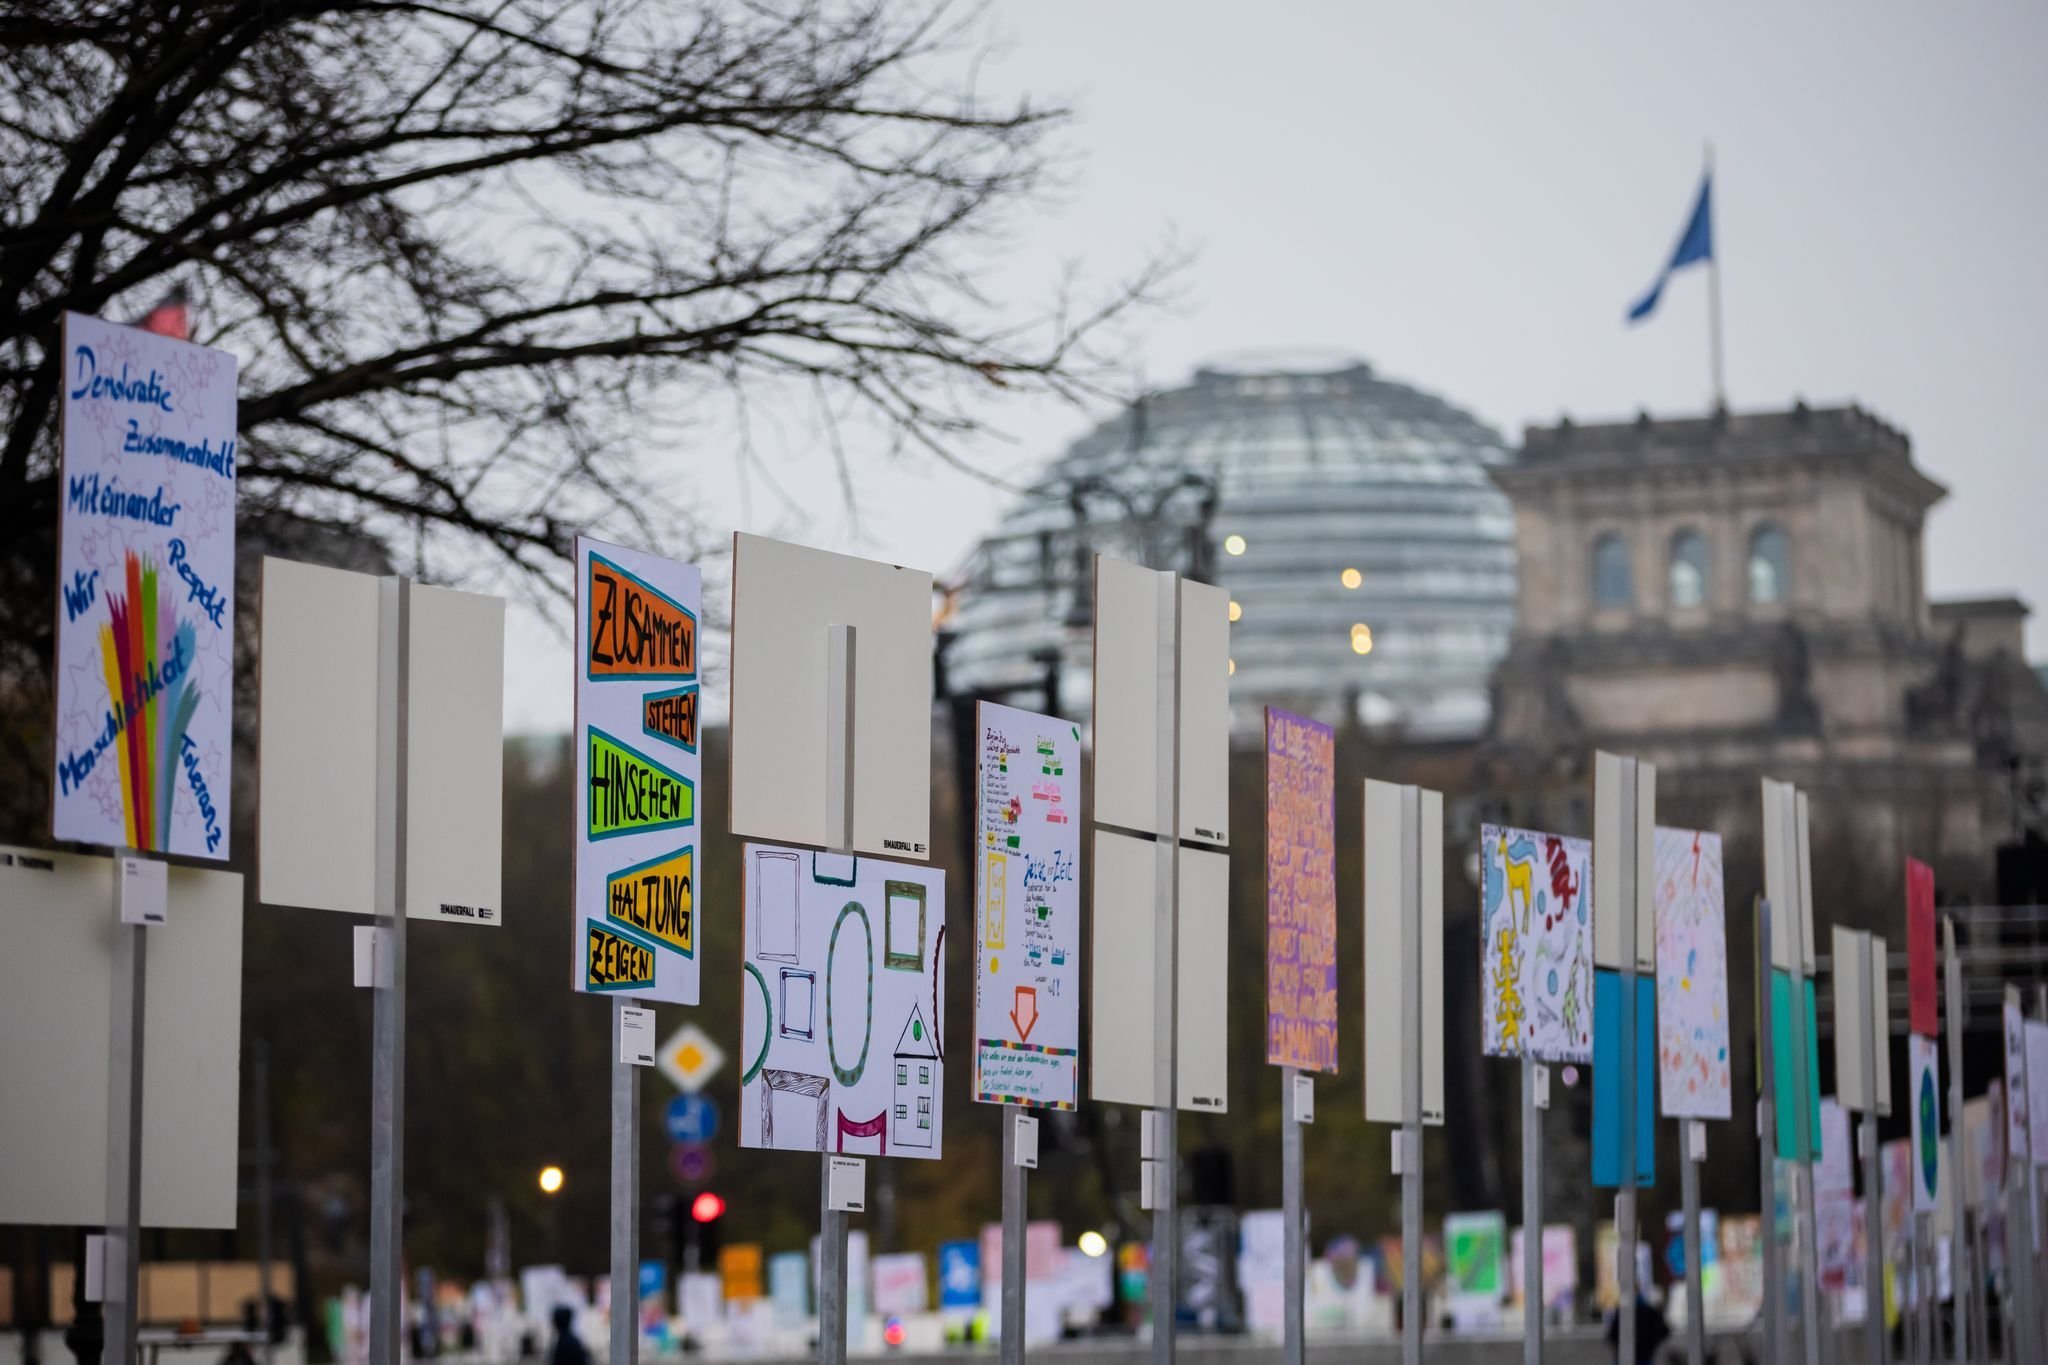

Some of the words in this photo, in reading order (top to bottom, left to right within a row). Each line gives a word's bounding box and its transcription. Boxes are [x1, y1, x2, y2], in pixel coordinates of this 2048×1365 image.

[124, 418, 235, 480] Zusammenhalt
[69, 473, 182, 528] Miteinander
[63, 569, 100, 623] Wir
[168, 538, 227, 630] Respekt
[594, 573, 691, 668] ZUSAMMEN
[648, 693, 697, 743] STEHEN
[591, 743, 681, 827] HINSEHEN
[612, 875, 692, 942] HALTUNG
[590, 928, 650, 986] ZEIGEN
